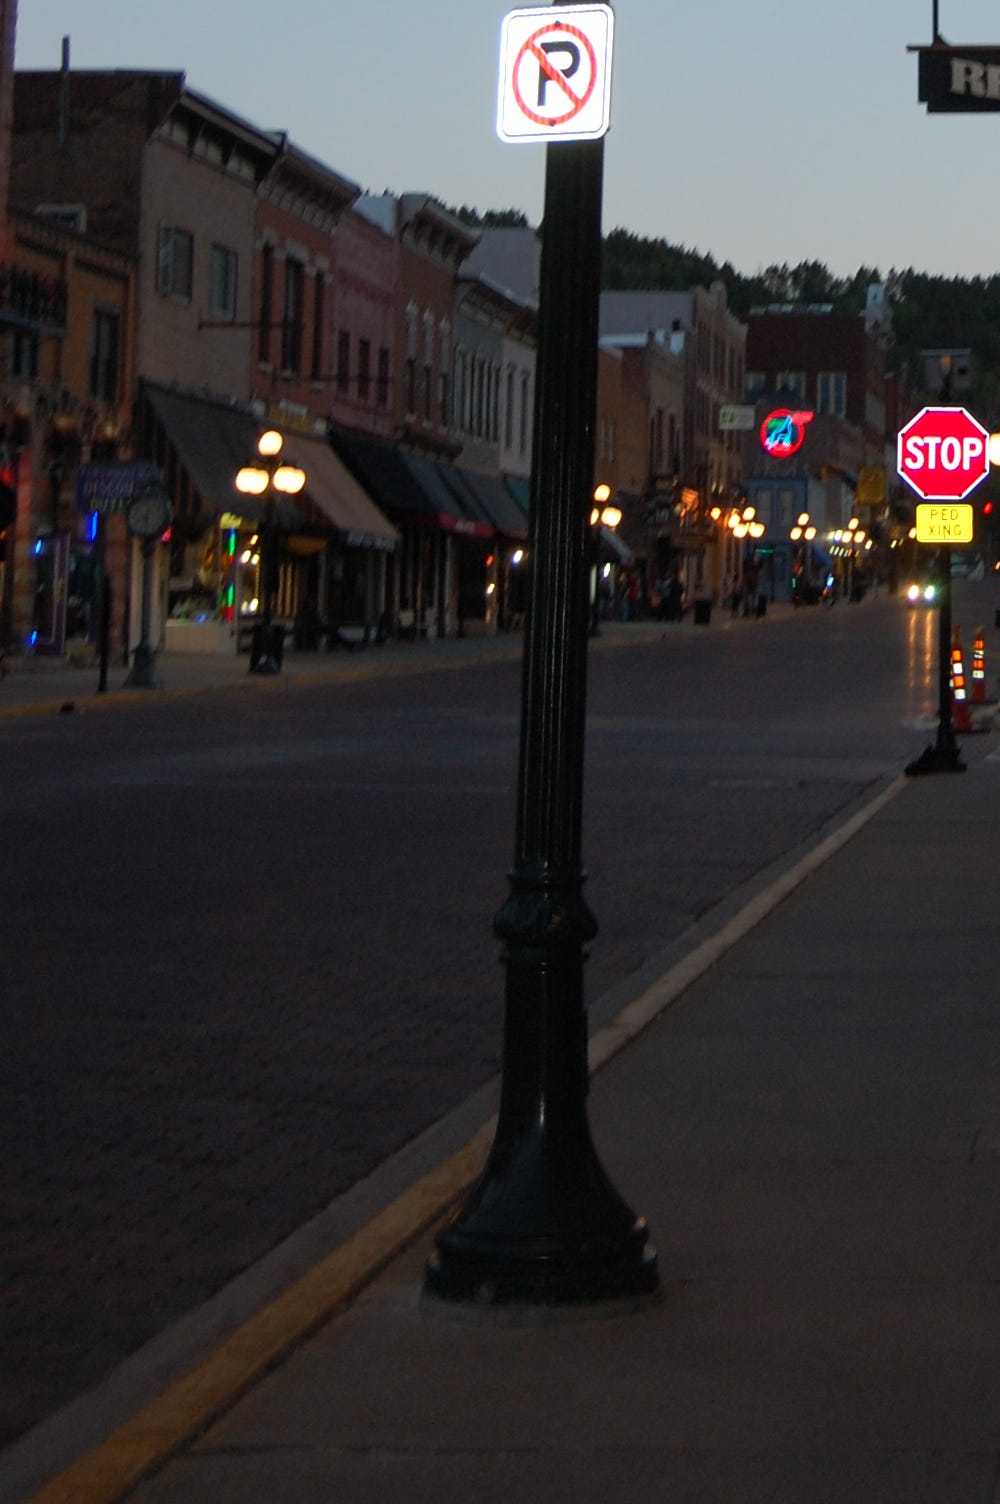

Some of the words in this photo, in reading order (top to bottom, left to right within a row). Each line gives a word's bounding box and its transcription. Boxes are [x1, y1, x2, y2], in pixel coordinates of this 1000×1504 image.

[904, 436, 983, 471] STOP
[930, 508, 959, 521] PED
[928, 524, 962, 537] XING
